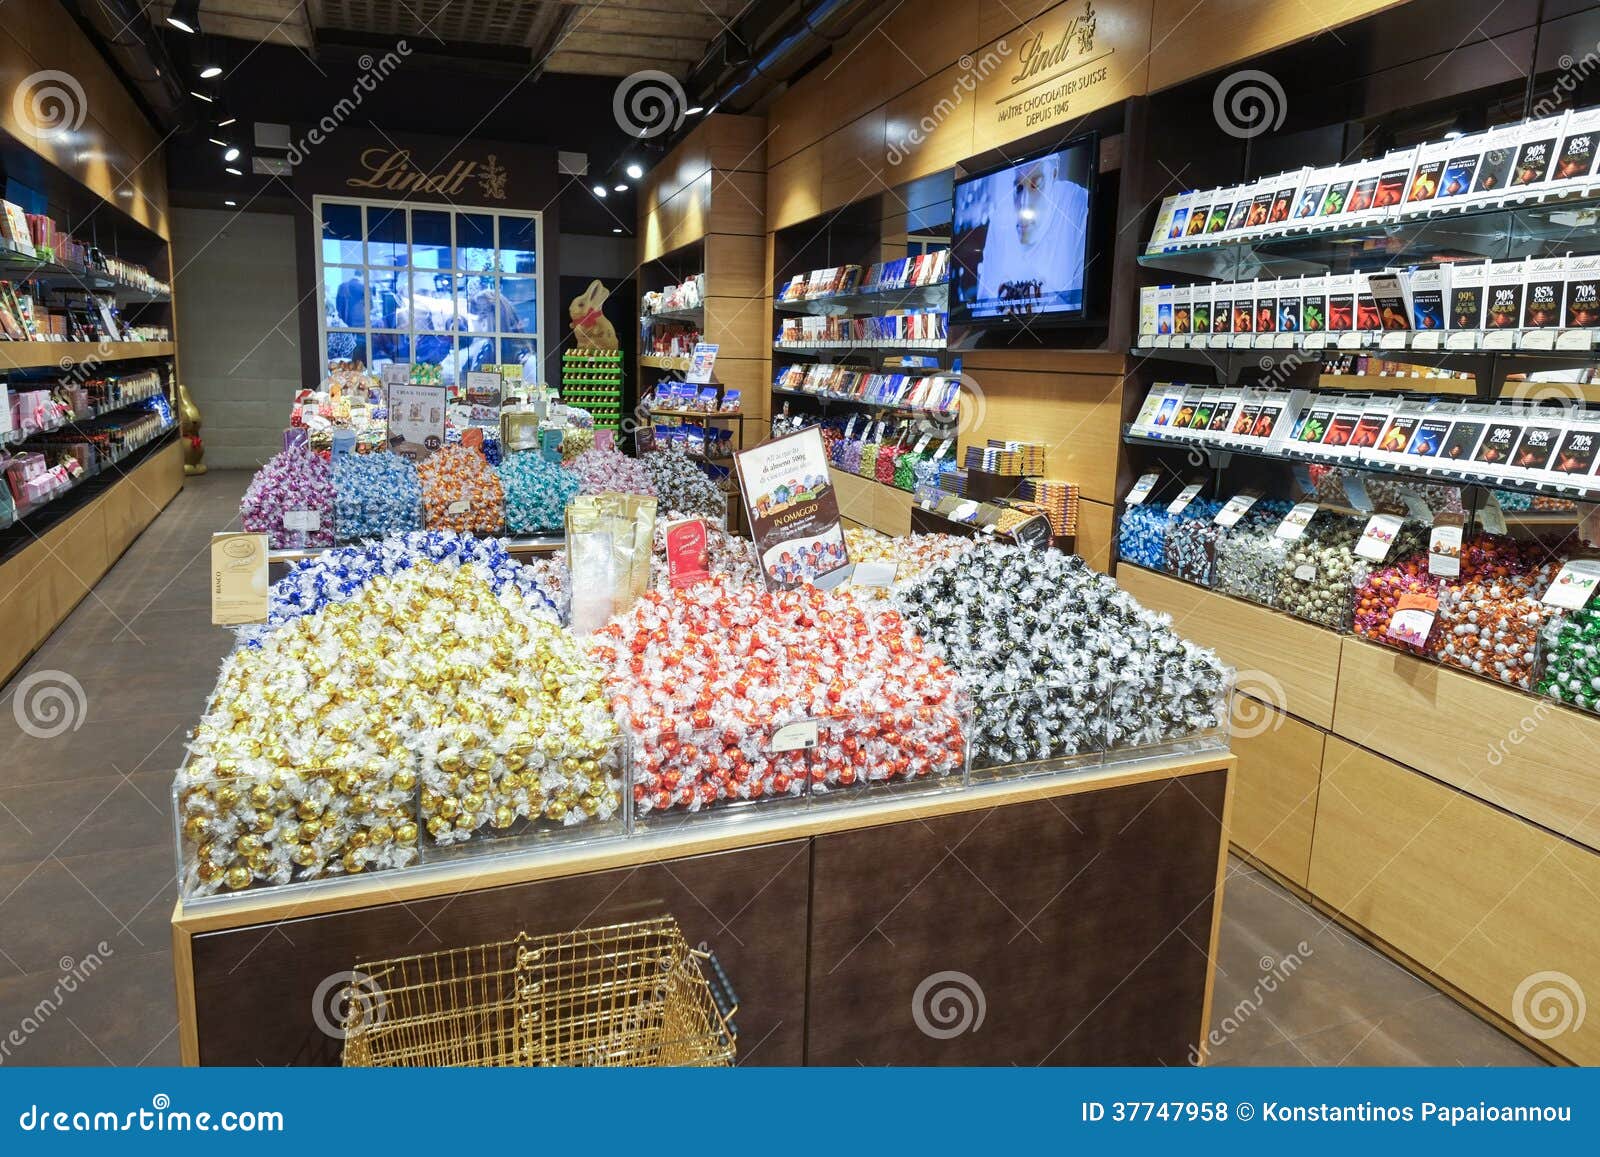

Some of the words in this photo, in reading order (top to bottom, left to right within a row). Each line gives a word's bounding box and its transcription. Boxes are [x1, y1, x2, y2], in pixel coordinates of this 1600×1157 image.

[1011, 16, 1079, 84] Lindt
[998, 102, 1023, 122] MAÎTRE
[1024, 81, 1077, 112] CHOCOLATIER
[1078, 67, 1107, 90] SUISSE
[1026, 107, 1051, 127] DEPUIS
[1054, 100, 1070, 116] 1845
[1570, 137, 1591, 149] 85%
[1527, 144, 1546, 157] 90%
[346, 148, 478, 195] Lindt
[1458, 290, 1475, 301] 99%
[1496, 289, 1514, 300] 90%
[1535, 286, 1553, 297] 85%
[1576, 285, 1596, 297] 70%
[1494, 428, 1513, 438] 90%
[1530, 431, 1550, 441] 85%
[1573, 435, 1592, 446] 70%
[774, 517, 783, 527] IN
[783, 503, 818, 523] OMAGGIO
